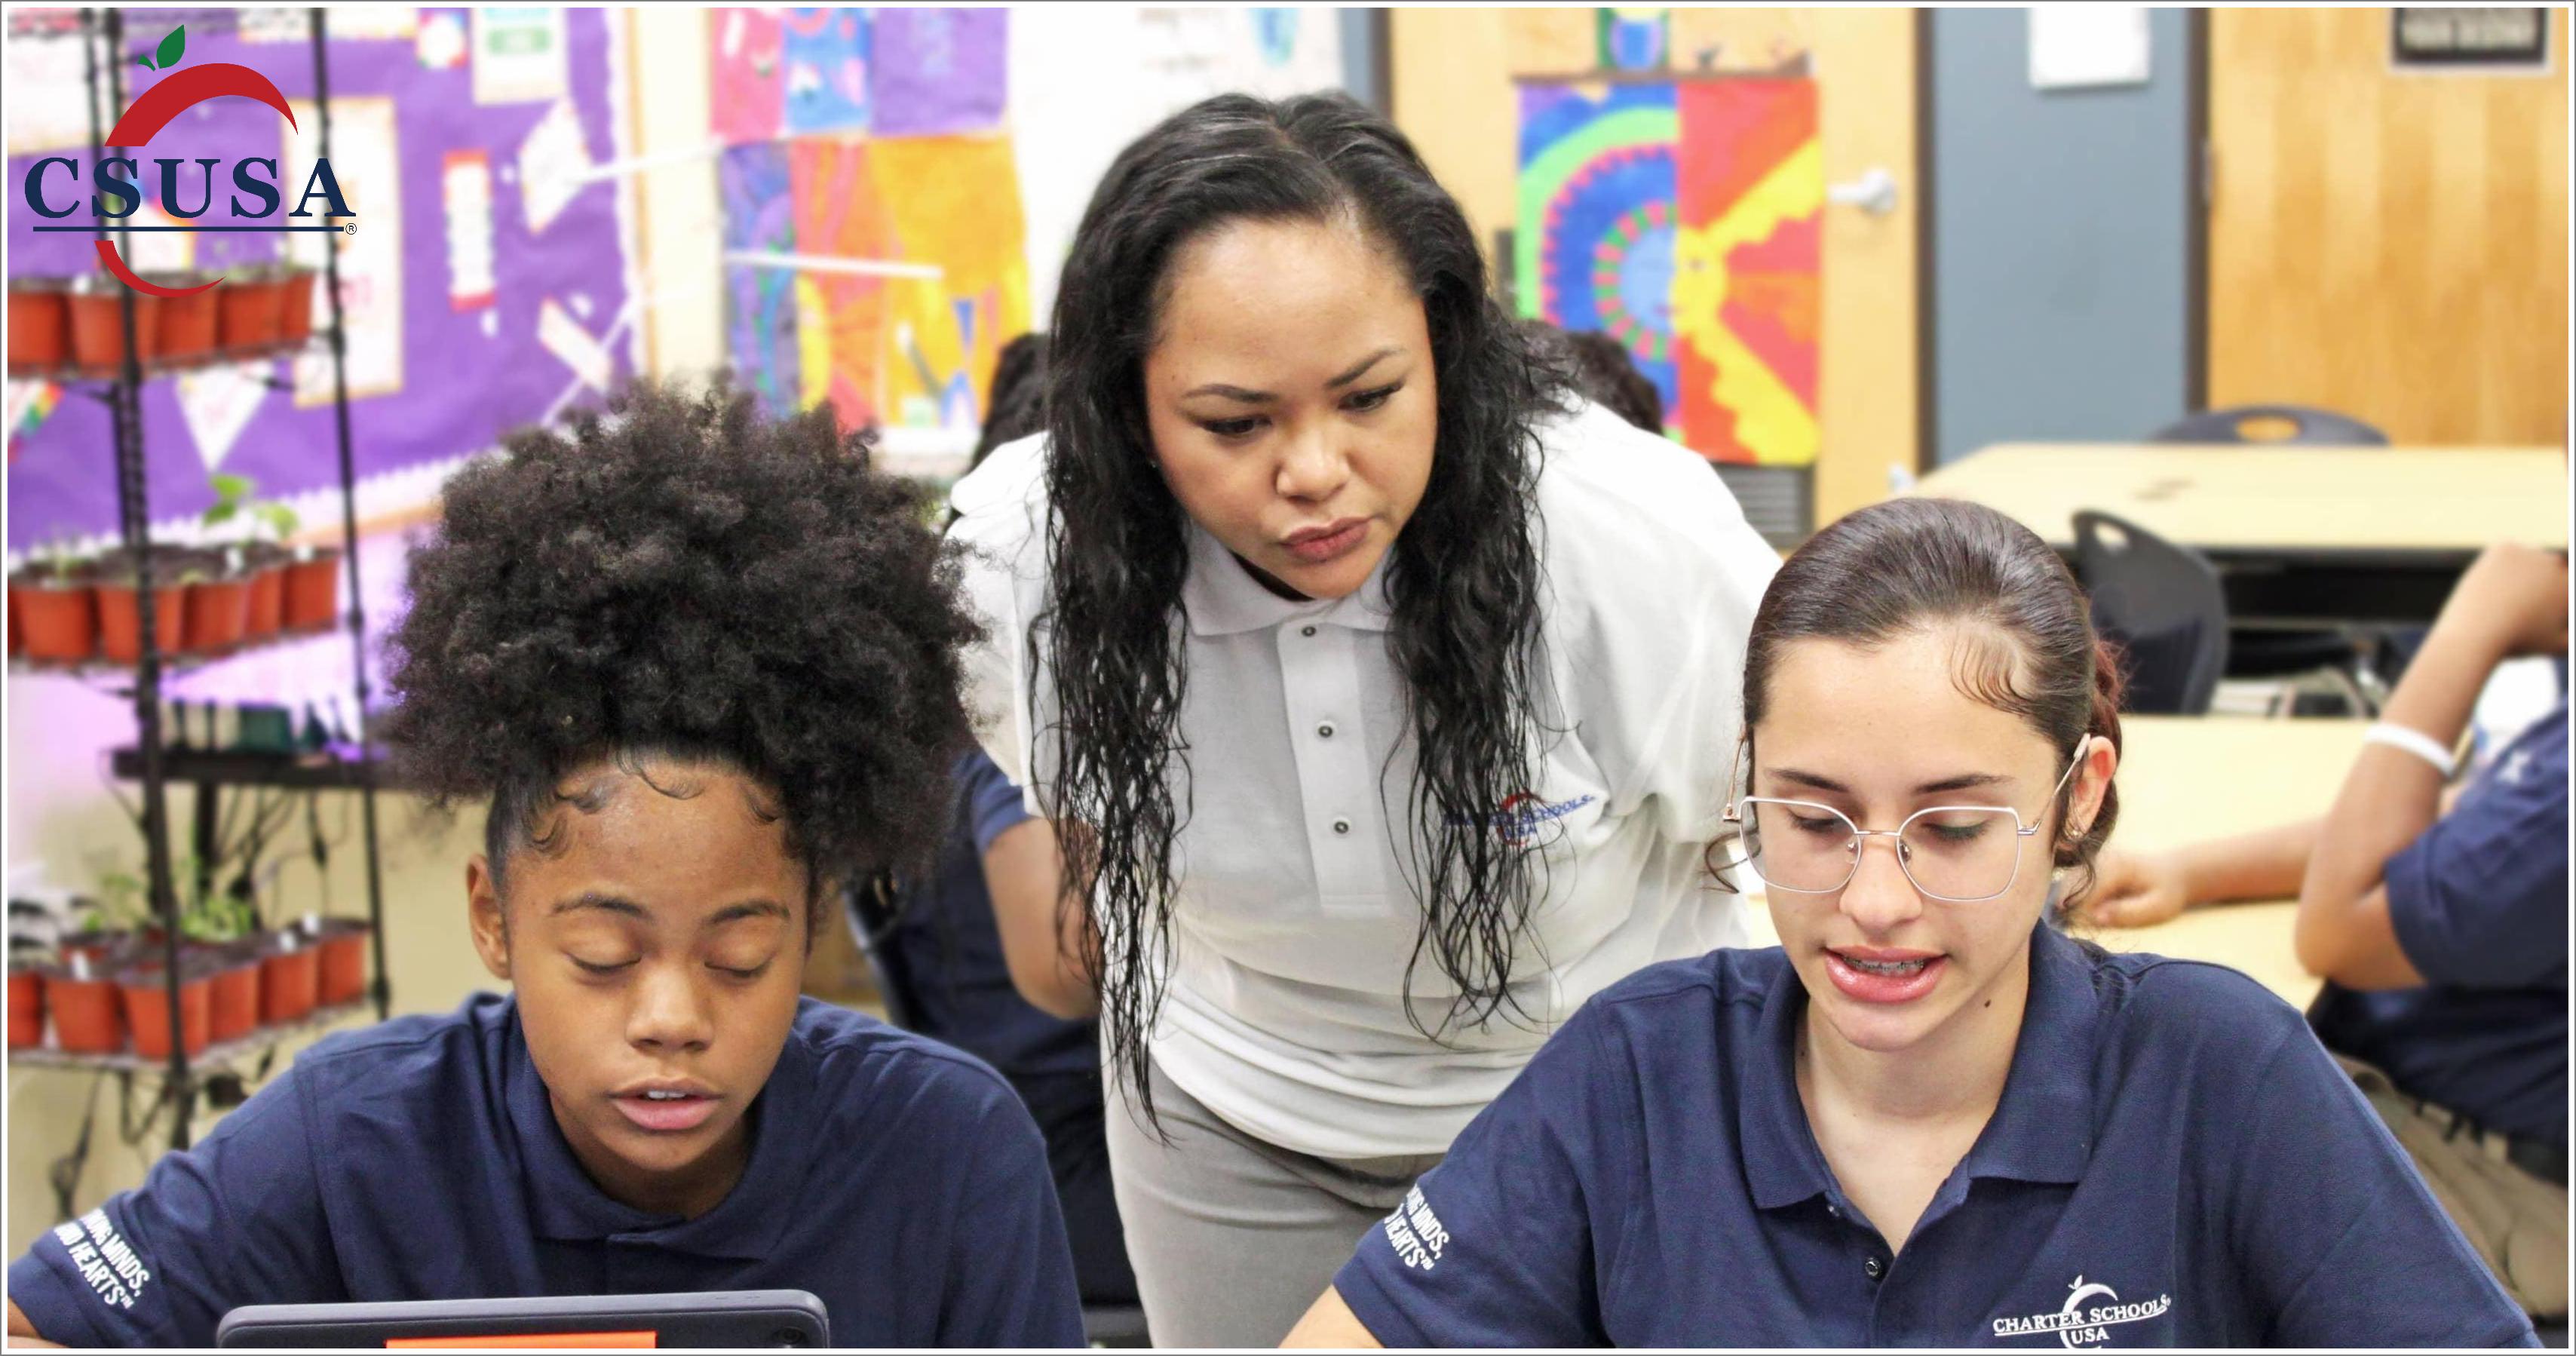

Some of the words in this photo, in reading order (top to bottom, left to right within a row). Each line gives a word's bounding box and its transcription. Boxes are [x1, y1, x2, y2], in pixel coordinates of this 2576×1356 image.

[100, 1233, 150, 1298] MINDS,
[1992, 1310, 2086, 1333] CHARTER
[2070, 1327, 2111, 1344] USA
